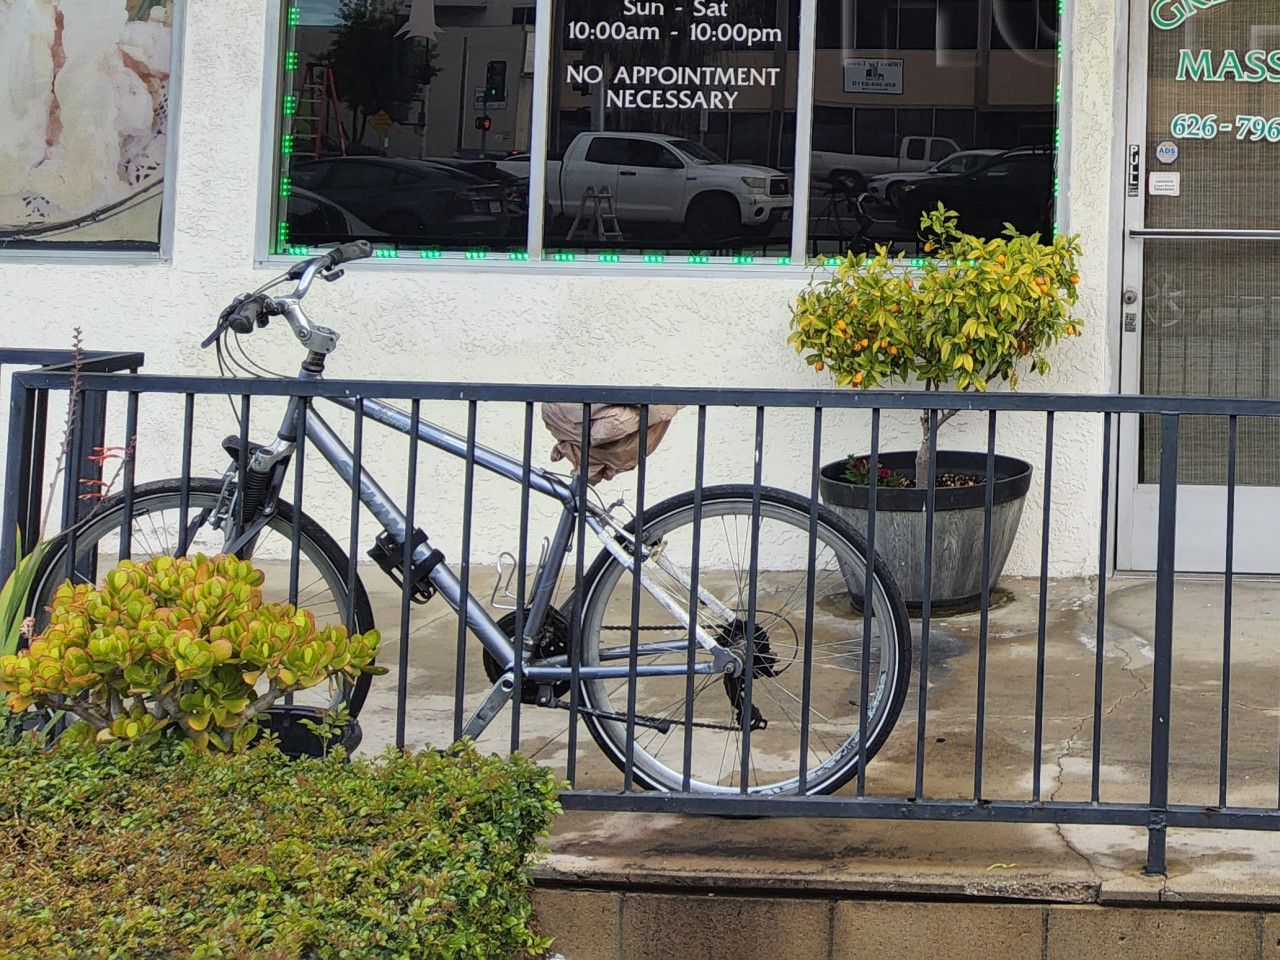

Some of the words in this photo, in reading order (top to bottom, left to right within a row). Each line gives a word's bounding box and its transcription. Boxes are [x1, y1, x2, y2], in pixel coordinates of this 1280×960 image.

[568, 20, 660, 40] 10:00am
[690, 23, 782, 46] 10:00pm
[566, 65, 603, 84] NO
[613, 66, 780, 86] APPOINTMENT
[606, 90, 739, 109] NECESSARY
[1129, 145, 1139, 184] PULL
